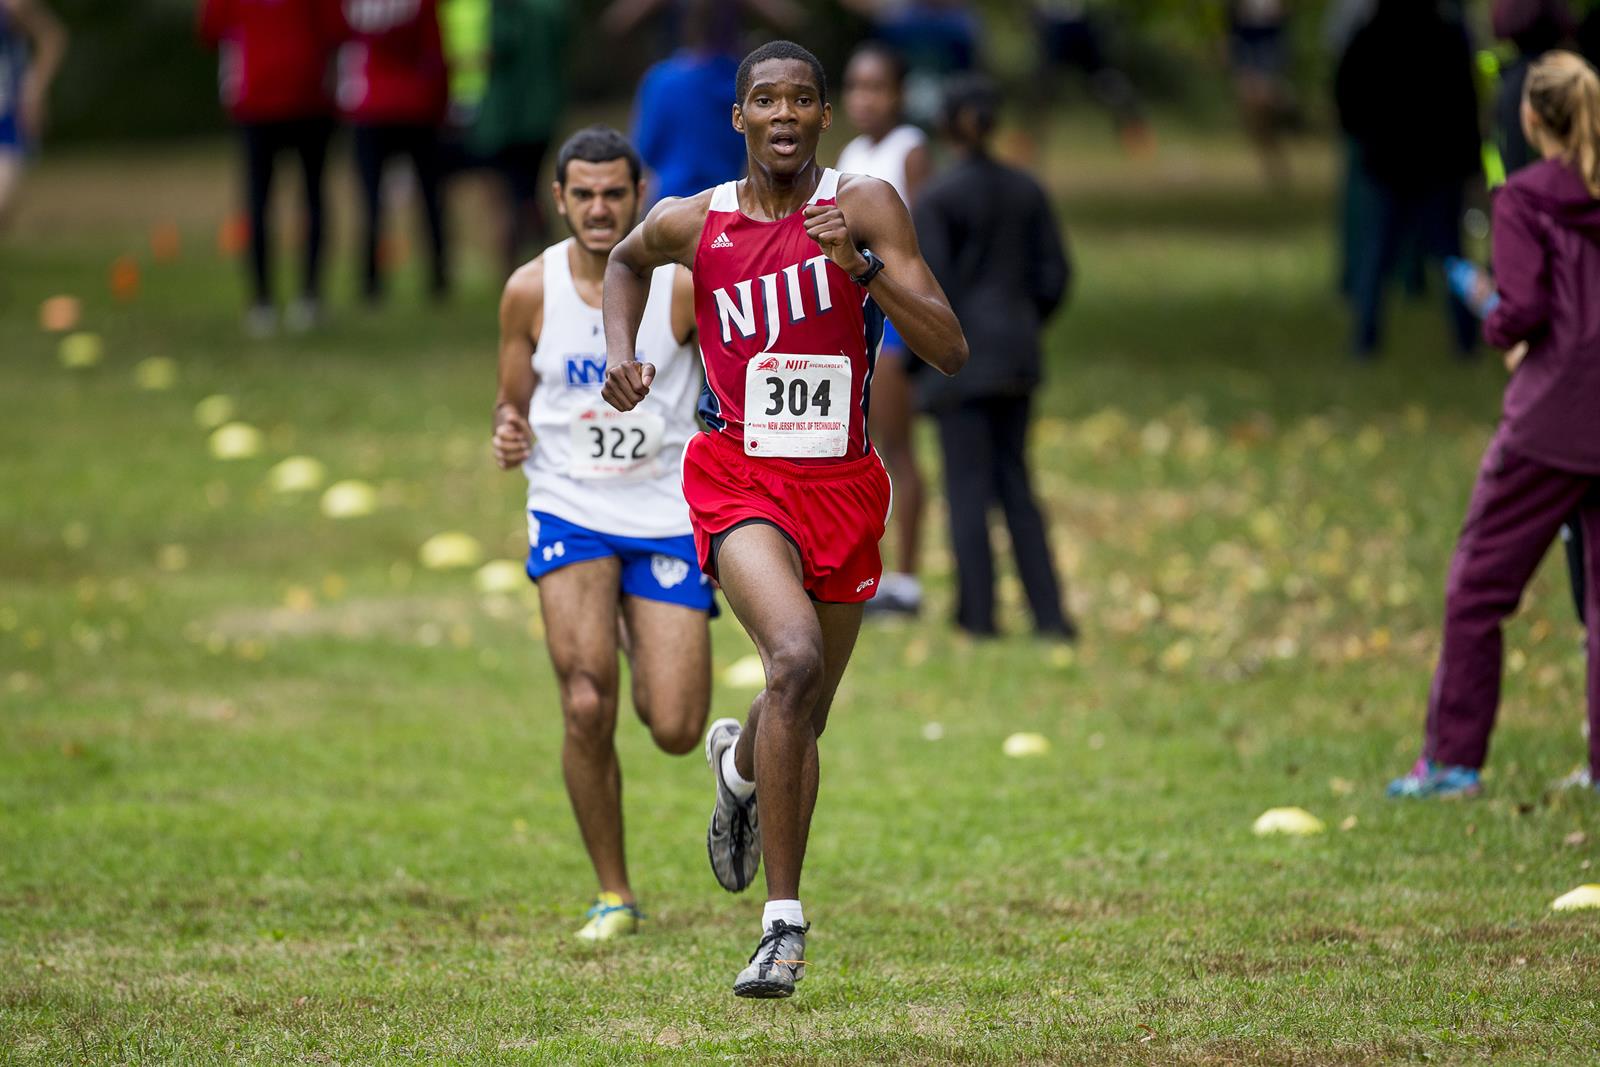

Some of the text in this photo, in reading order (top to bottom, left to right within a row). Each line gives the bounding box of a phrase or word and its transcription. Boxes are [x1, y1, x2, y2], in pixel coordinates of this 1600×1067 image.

[712, 255, 832, 353] NJIT
[785, 359, 809, 371] NJIT
[765, 376, 832, 416] 304
[590, 426, 646, 459] 322
[768, 422, 778, 430] NEW
[779, 422, 795, 430] JERSEY
[807, 422, 814, 430] OF
[814, 422, 841, 430] TECHNOLOGY
